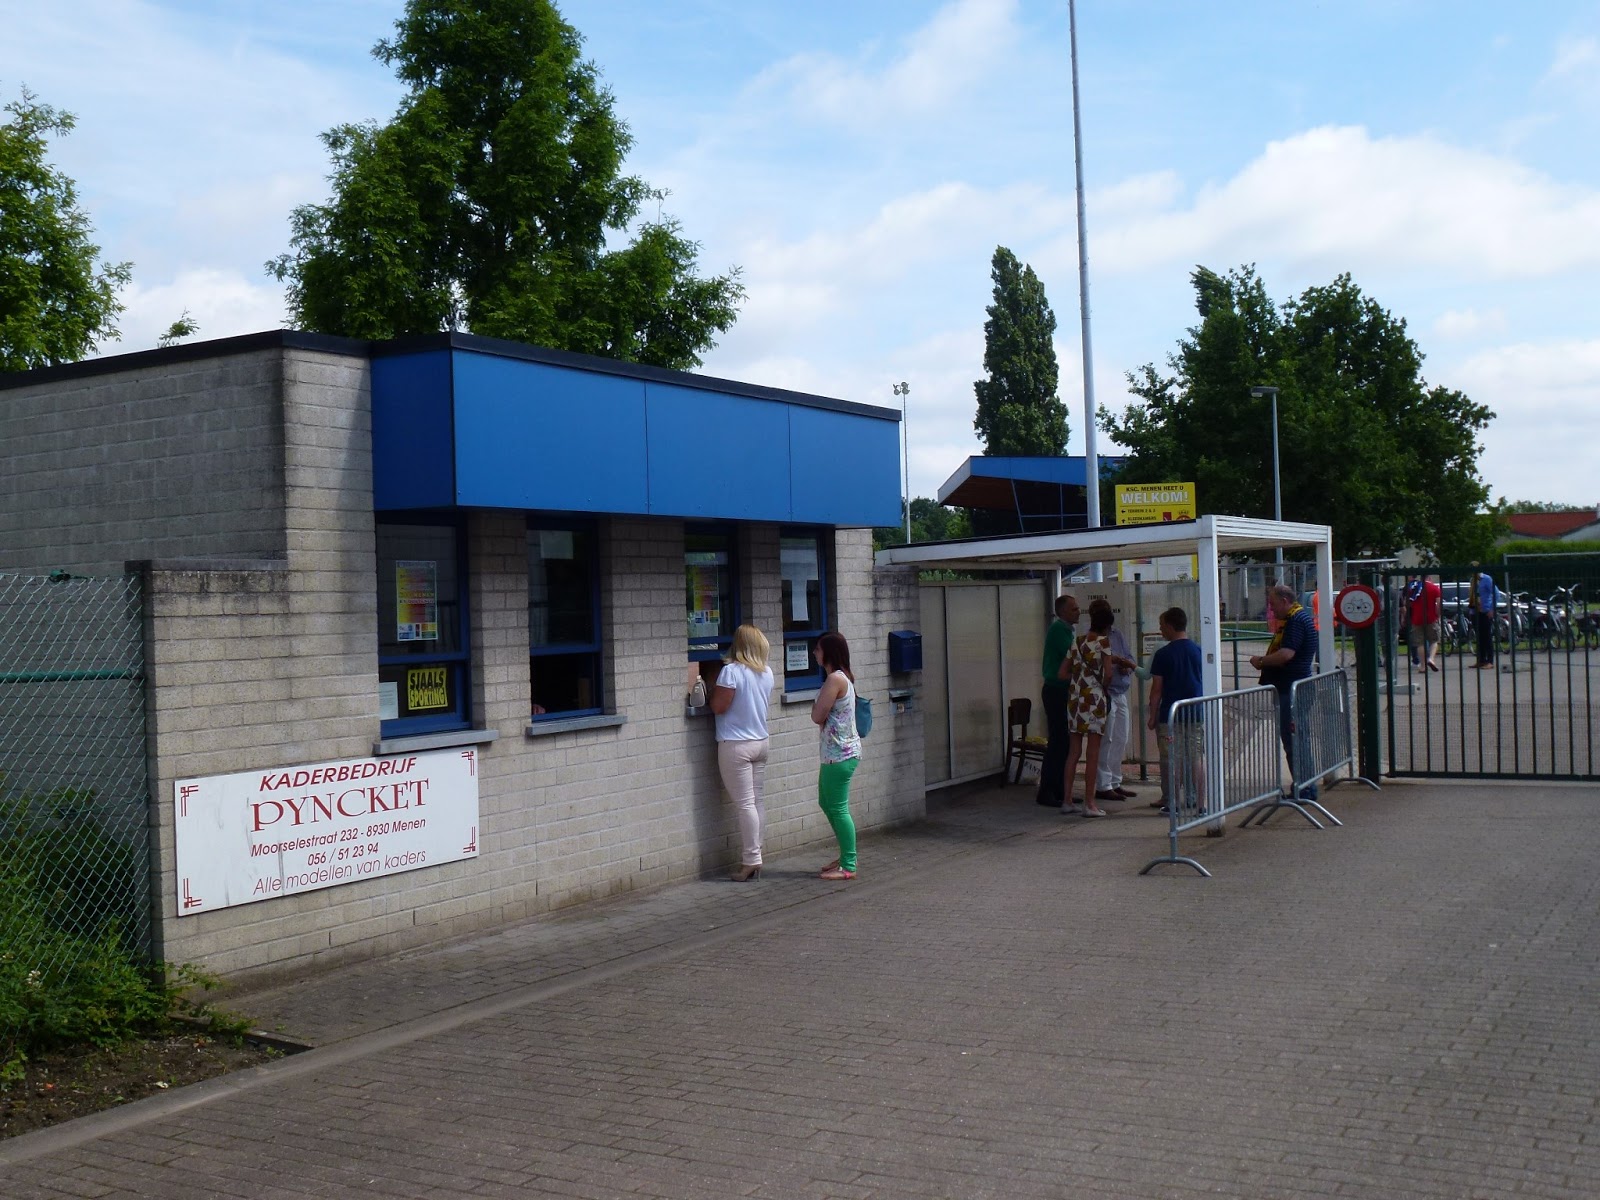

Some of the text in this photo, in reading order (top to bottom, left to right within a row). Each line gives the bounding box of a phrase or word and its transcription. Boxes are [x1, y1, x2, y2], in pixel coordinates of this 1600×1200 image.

[1121, 491, 1188, 504] WELKOM!
[410, 671, 444, 690] SJAALS
[410, 688, 446, 708] SPORTING
[259, 757, 417, 792] KADERBEDRIJF
[250, 778, 429, 833] PYNCKET
[251, 834, 338, 857] Moorselestraat
[340, 830, 359, 843] 232
[366, 824, 390, 838] 8930
[391, 818, 426, 833] Menen
[307, 852, 327, 867] 056
[337, 848, 350, 861] 51
[352, 846, 365, 859] 23
[366, 843, 379, 856] 94
[253, 850, 427, 896] Alle modellen van kaders
